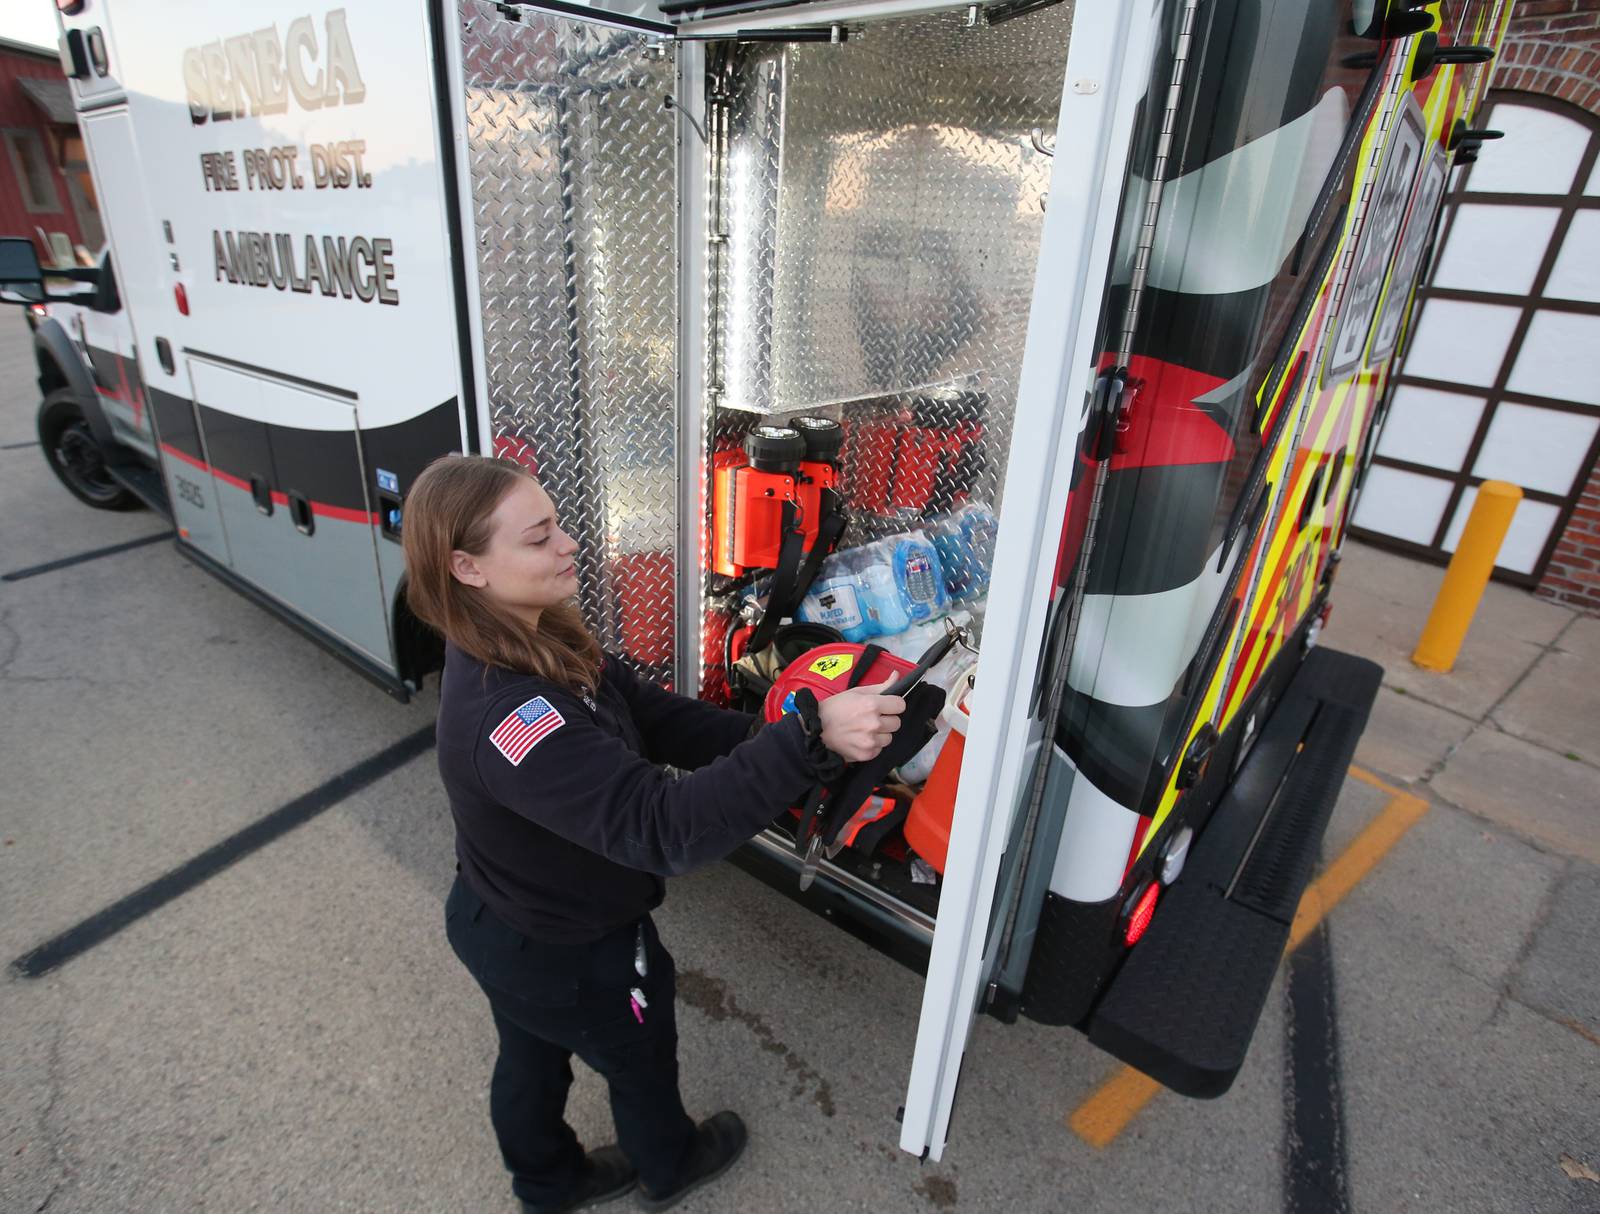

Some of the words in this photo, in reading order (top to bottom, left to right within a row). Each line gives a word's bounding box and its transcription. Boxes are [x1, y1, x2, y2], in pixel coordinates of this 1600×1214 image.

[183, 8, 366, 127] SENECA
[200, 151, 239, 191] FIRE
[243, 146, 304, 190] PROT.
[310, 140, 372, 189] DIST.
[213, 230, 399, 306] AMBULANCE
